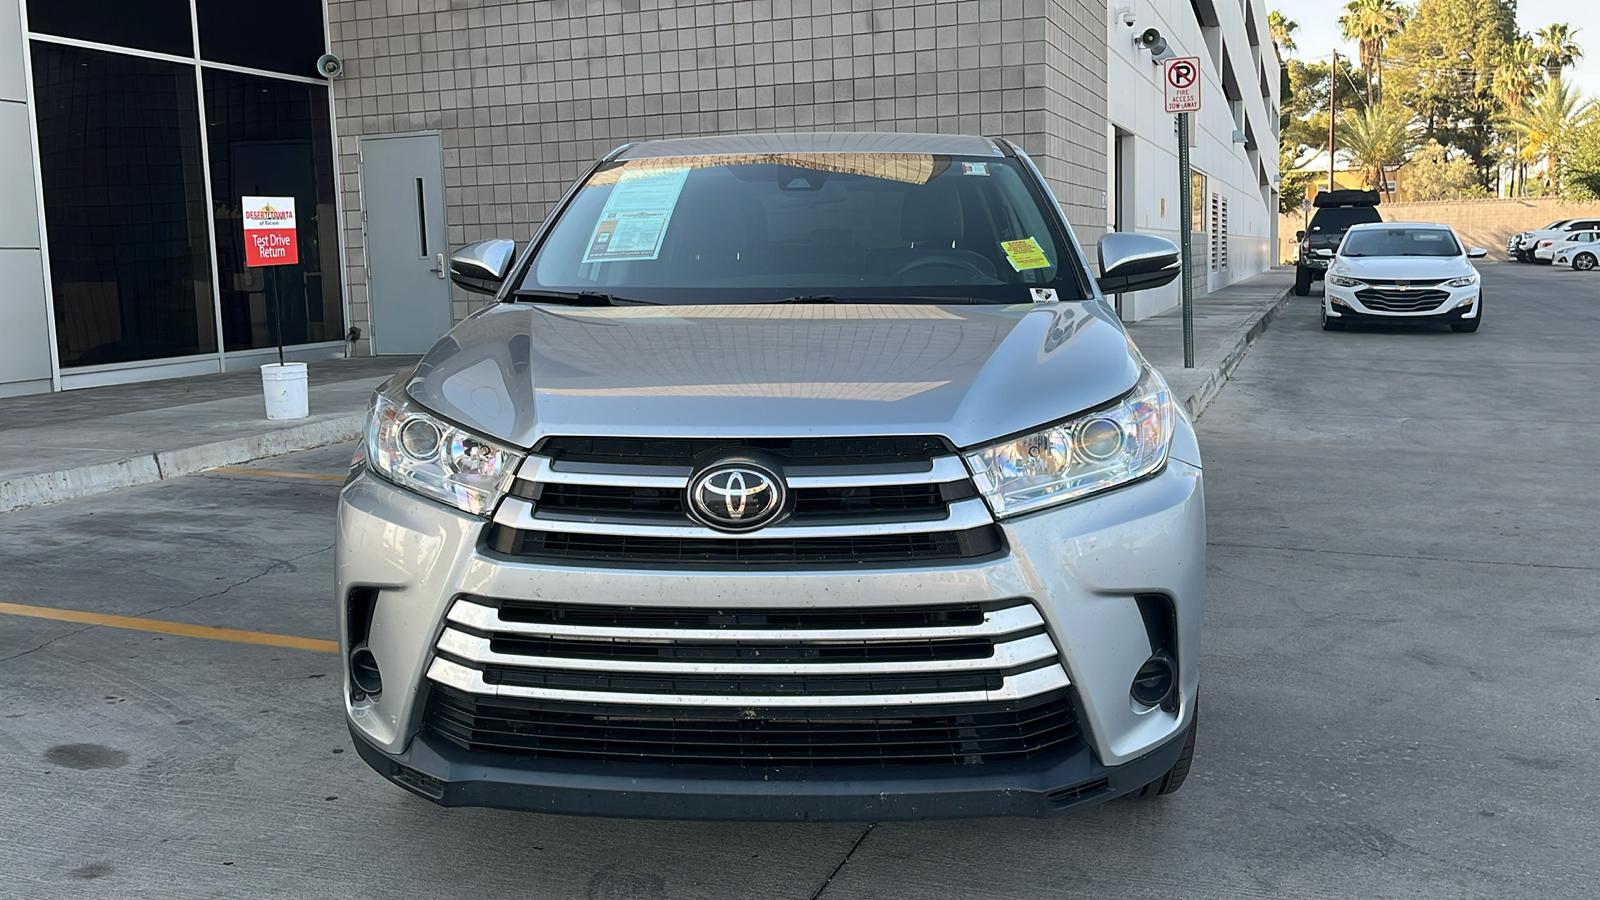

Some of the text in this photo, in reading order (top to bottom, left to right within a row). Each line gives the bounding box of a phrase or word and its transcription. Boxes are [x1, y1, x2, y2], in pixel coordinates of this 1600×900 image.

[1172, 95, 1195, 103] ACCESS
[245, 211, 293, 220] DESERT TOYOTA
[252, 233, 291, 247] Test Drive
[259, 245, 286, 258] Return
